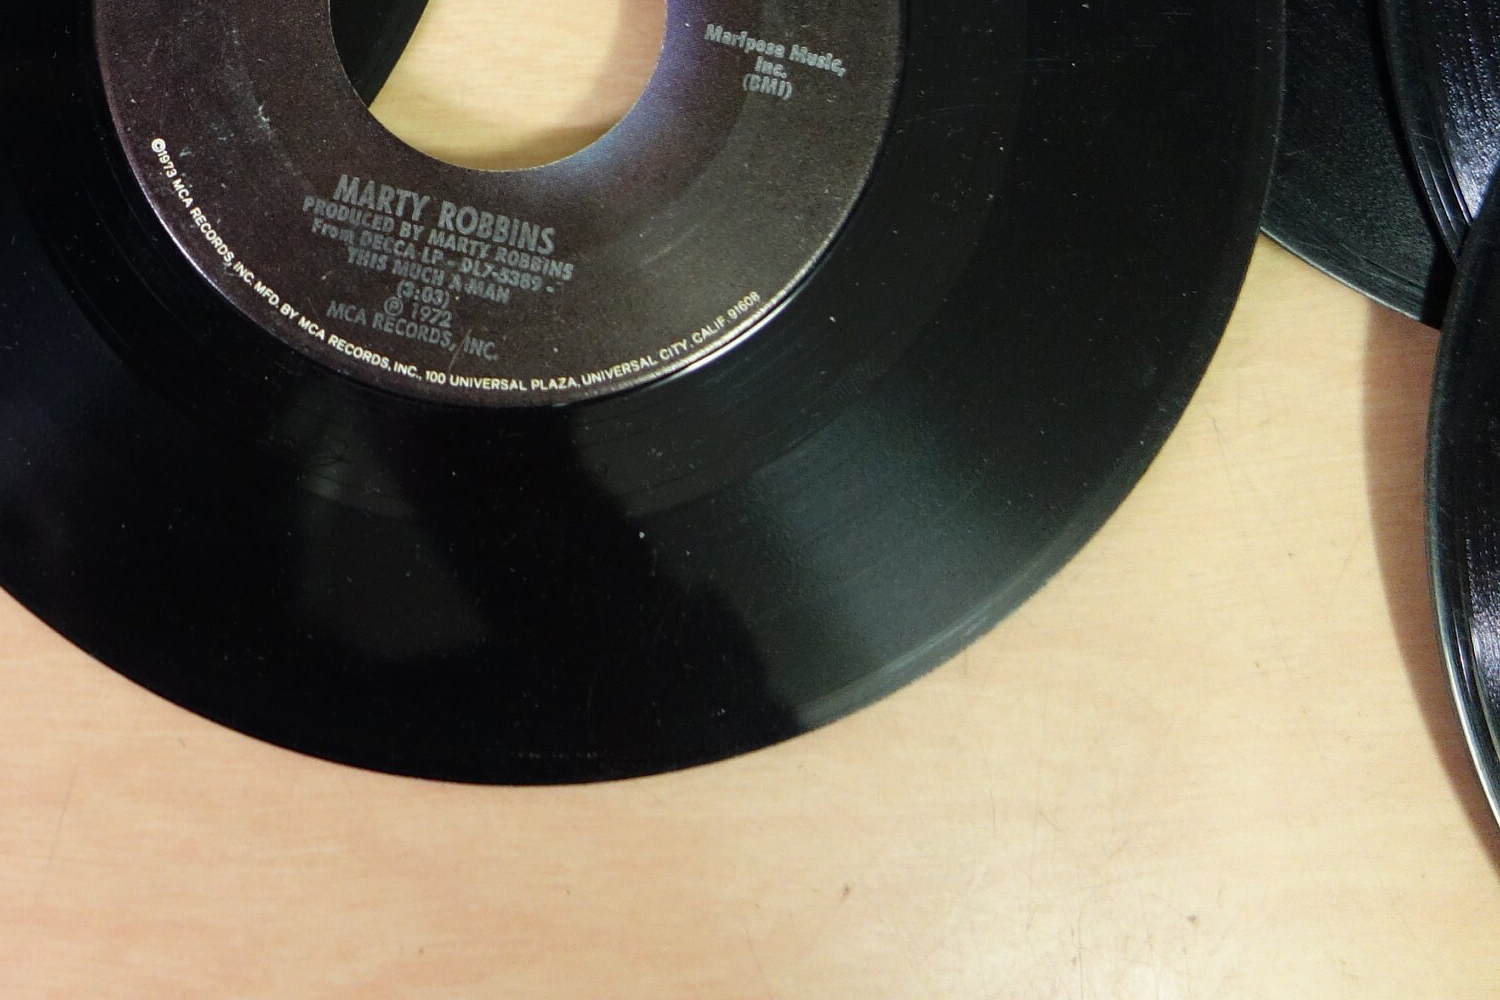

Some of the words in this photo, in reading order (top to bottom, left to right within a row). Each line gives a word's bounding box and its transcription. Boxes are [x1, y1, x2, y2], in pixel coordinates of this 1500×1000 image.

[754, 55, 788, 79] Inc.
[788, 44, 847, 78] Music,
[742, 73, 793, 101] (BMI)
[302, 195, 396, 234] PRODUCED
[399, 221, 425, 241] BY
[427, 228, 492, 260] MARTY
[494, 246, 574, 281] ROBBINS
[333, 174, 431, 221] MARTY
[438, 199, 556, 256] ROBBINS
[310, 216, 355, 245] From
[360, 230, 417, 260] DECCA
[420, 246, 445, 265] LP
[171, 178, 194, 208] MCA
[253, 280, 280, 309] MFD.
[279, 302, 300, 321] BY
[298, 315, 327, 341] MCA
[327, 333, 393, 373] RECORDS,
[425, 370, 447, 386] 100
[449, 373, 529, 392] UNIVERSAL
[581, 355, 658, 387] UNIVERSAL
[726, 290, 761, 321] 91608
[347, 245, 388, 272] THIS
[391, 260, 446, 287] MUCH
[447, 273, 462, 293] A
[463, 278, 510, 305] MAN
[396, 279, 451, 310] (3:03)
[325, 299, 367, 326] MCA
[371, 311, 456, 352] RECORDS,
[463, 334, 499, 361] INC.
[410, 301, 453, 329] 1972
